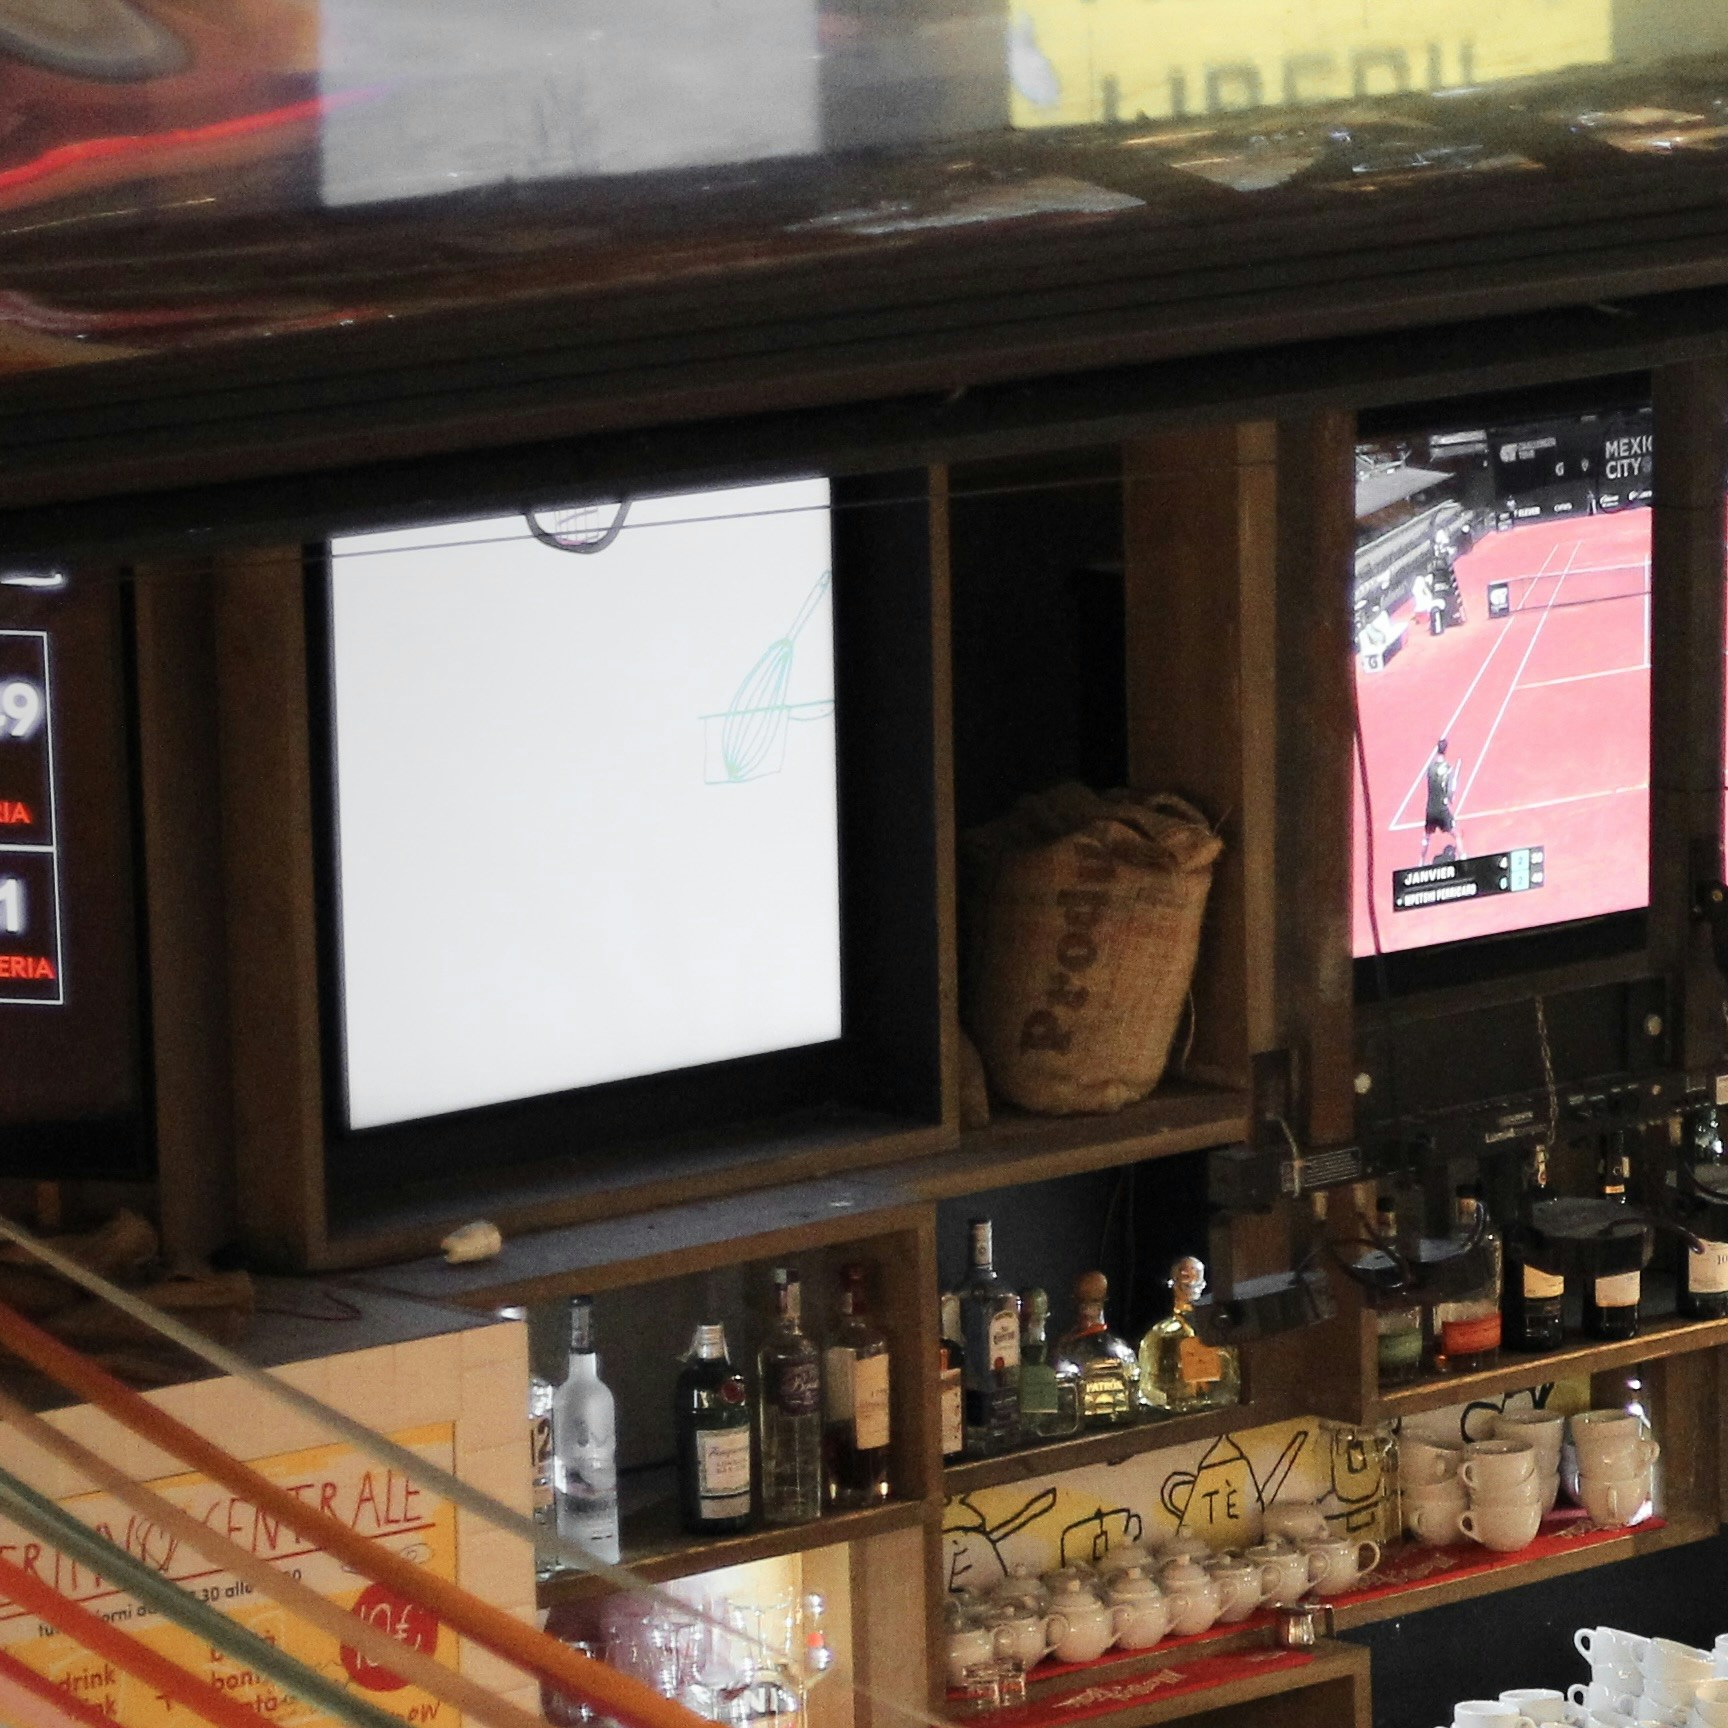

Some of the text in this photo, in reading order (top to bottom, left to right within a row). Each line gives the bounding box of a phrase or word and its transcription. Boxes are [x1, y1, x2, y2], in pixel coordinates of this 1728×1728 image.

[1605, 457, 1641, 480] CITY
[1404, 865, 1456, 887] JANVIER
[1202, 1480, 1240, 1523] TÈ
